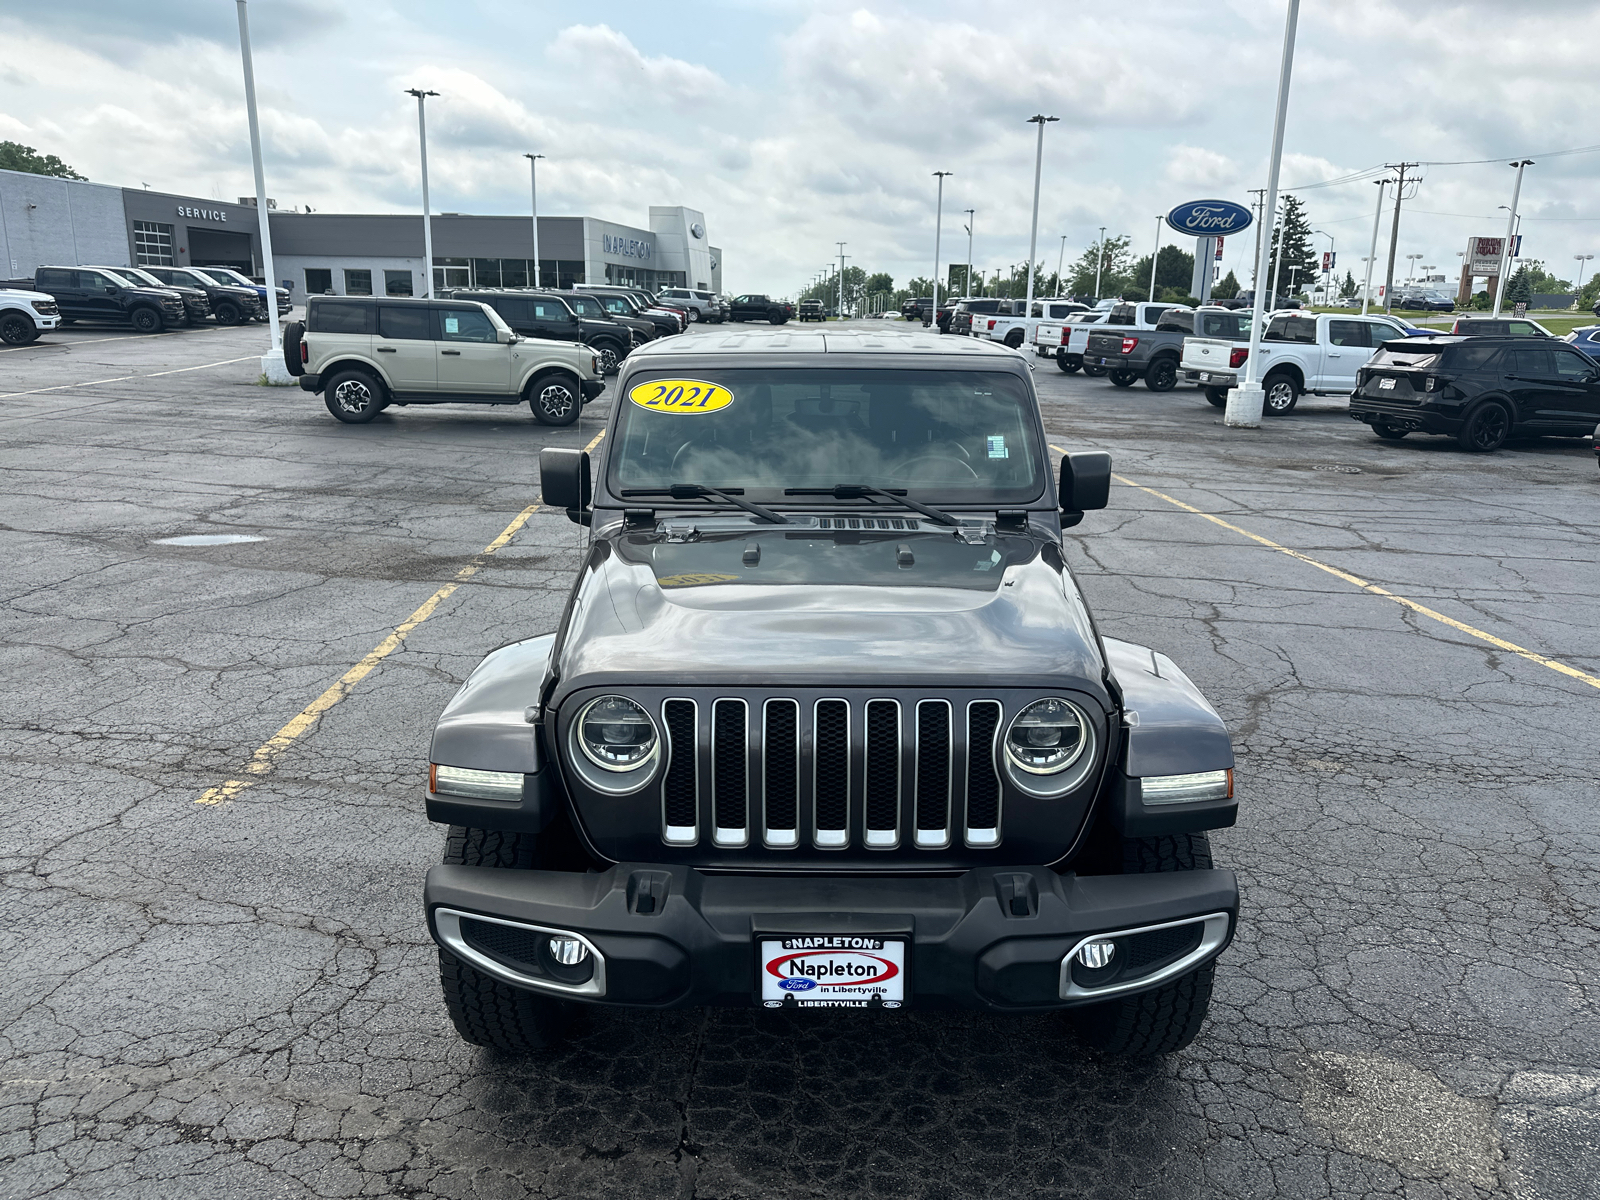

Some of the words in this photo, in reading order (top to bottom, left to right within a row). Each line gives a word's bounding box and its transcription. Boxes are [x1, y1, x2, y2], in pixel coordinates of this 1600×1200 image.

[178, 206, 227, 222] SERVICE
[1186, 206, 1236, 228] Ford
[603, 233, 651, 260] NAPLETON
[1477, 238, 1502, 247] FORUM
[1475, 246, 1502, 256] SQUARE
[645, 385, 717, 408] 2021
[791, 937, 875, 949] NAPLETON
[789, 960, 878, 980] Napleton
[786, 979, 809, 990] Ford
[832, 986, 888, 995] Libertyville
